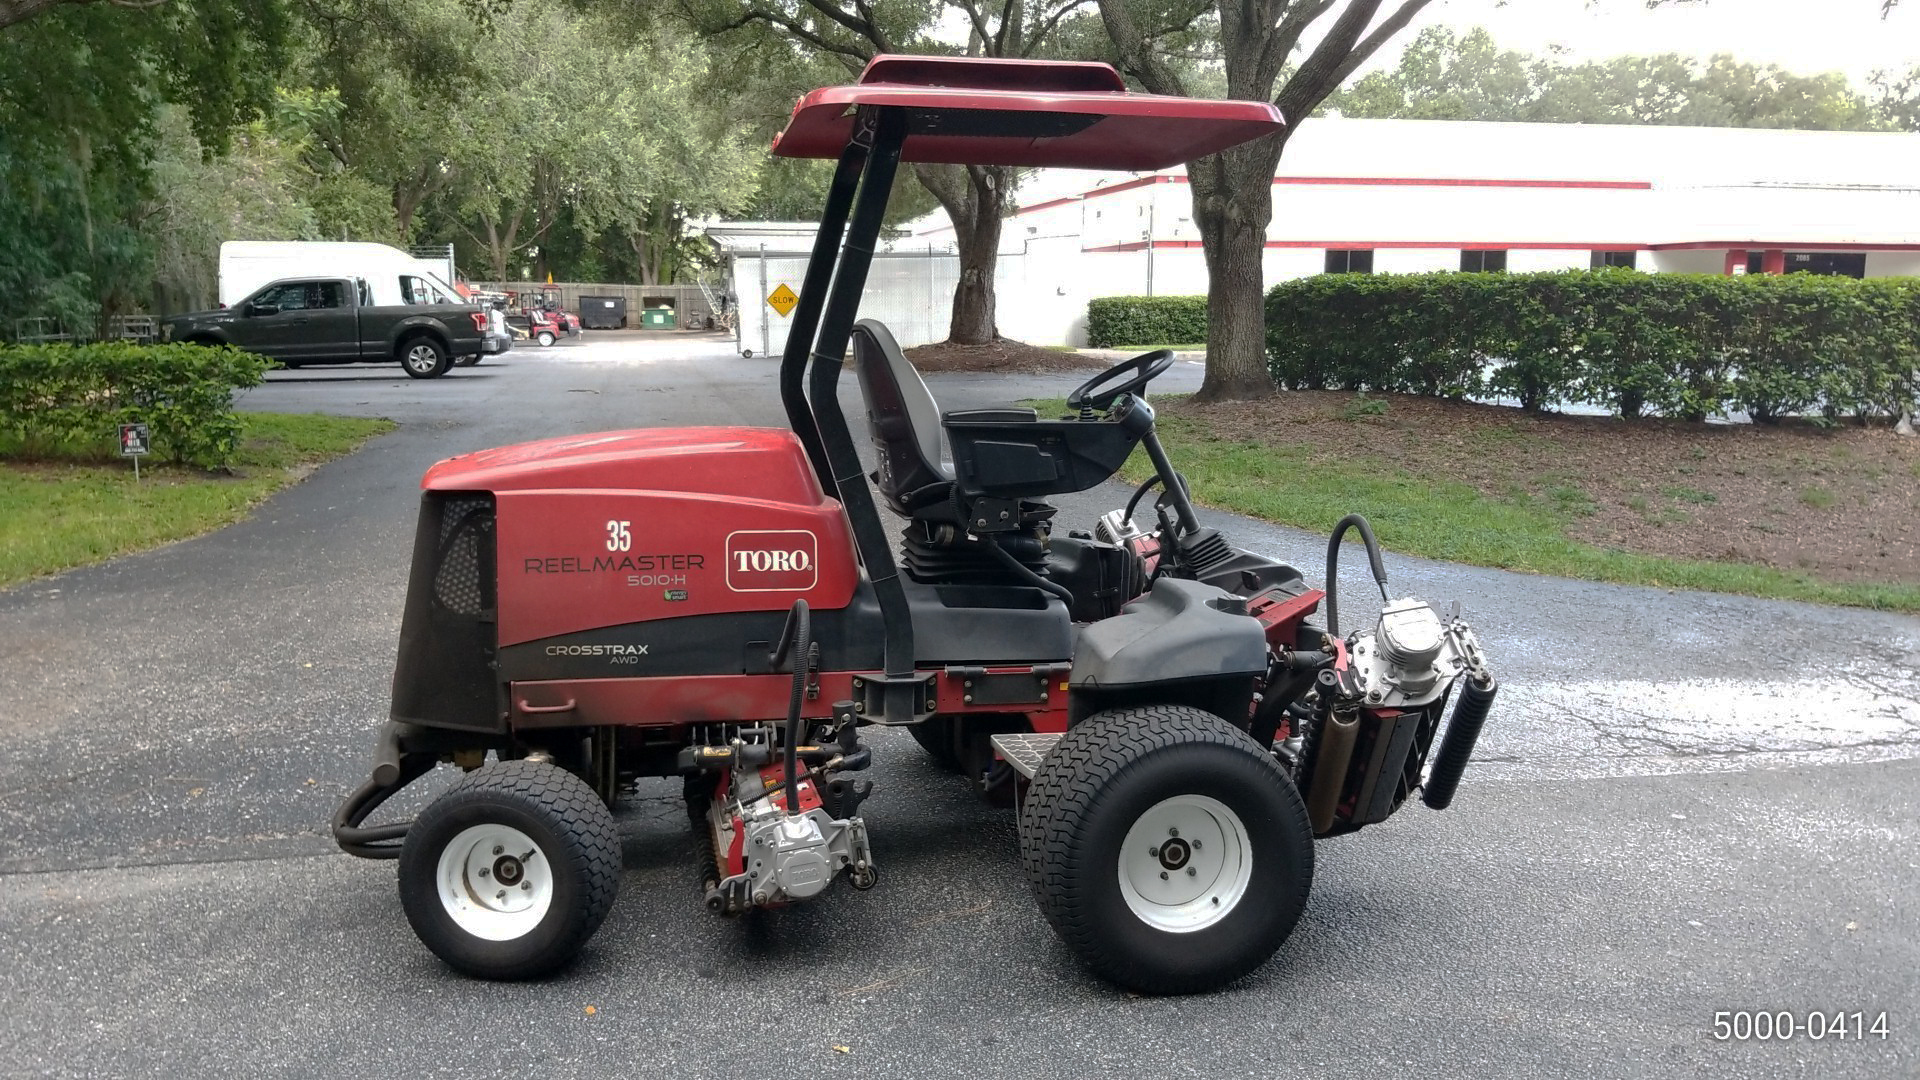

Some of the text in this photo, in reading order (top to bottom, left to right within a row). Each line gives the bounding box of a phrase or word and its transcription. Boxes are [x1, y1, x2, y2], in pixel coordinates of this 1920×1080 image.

[772, 296, 795, 304] SLOW
[606, 520, 632, 552] 35
[524, 554, 705, 574] REELMASTER
[734, 550, 811, 571] TORO
[545, 644, 649, 657] CROSSTRAX
[610, 656, 639, 665] AWD
